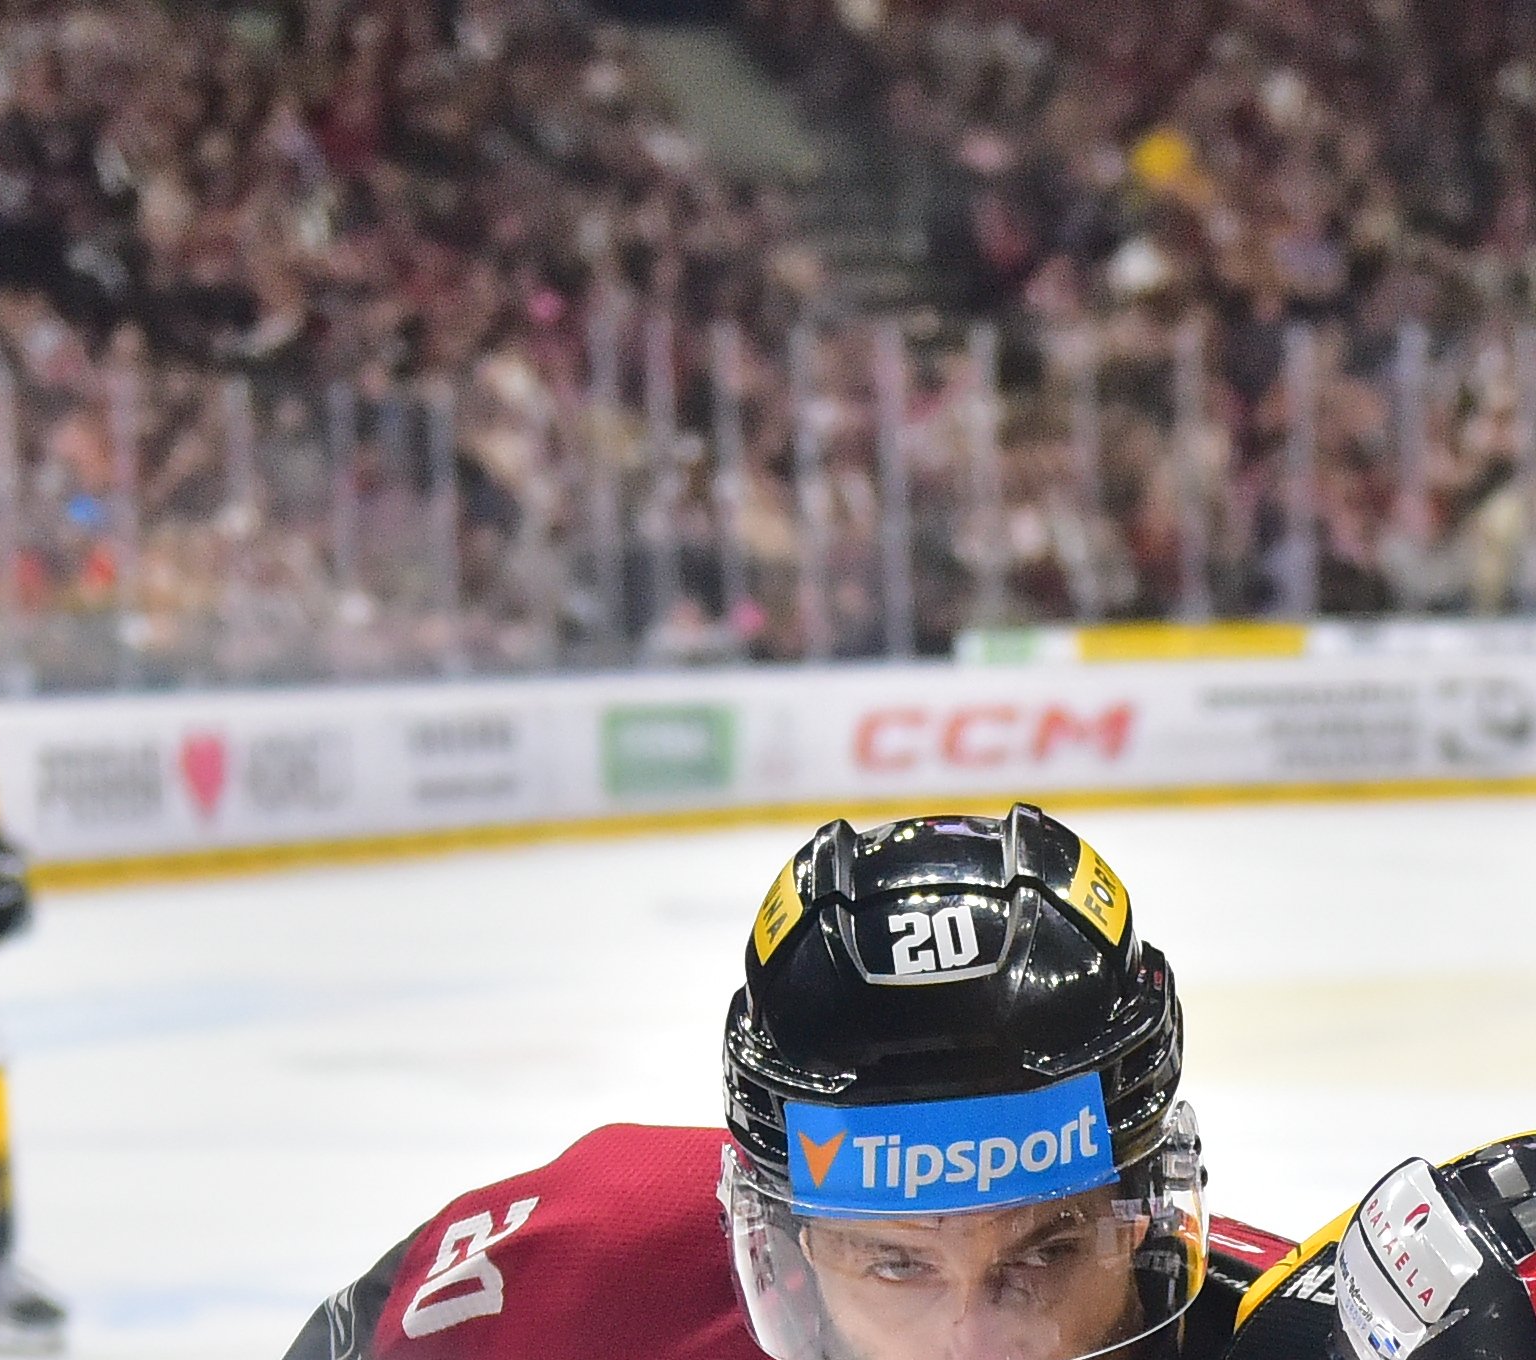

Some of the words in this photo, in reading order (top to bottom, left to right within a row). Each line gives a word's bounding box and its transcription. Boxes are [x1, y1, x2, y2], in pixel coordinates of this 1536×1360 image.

[852, 698, 1134, 775] CCM
[889, 906, 980, 976] 20
[852, 1104, 1099, 1198] Tipsport
